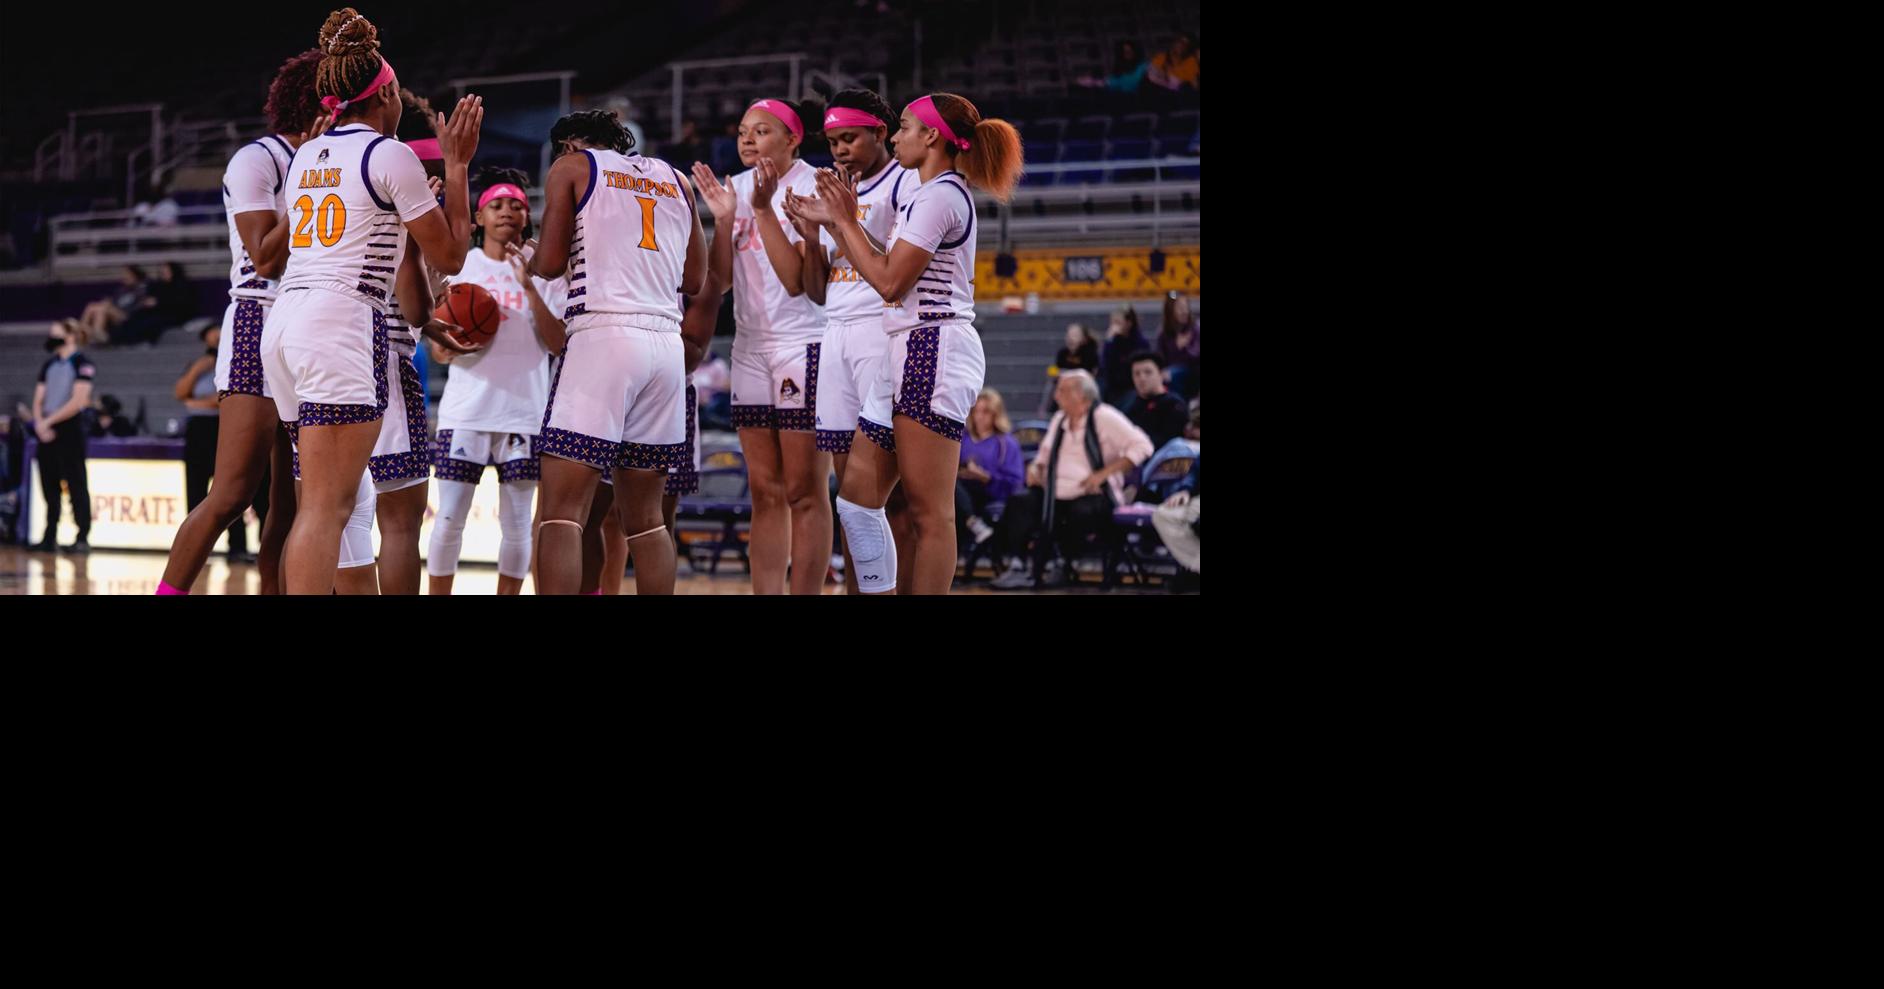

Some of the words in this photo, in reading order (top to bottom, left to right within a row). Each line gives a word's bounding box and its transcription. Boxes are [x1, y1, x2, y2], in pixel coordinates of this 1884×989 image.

[298, 167, 342, 189] ADAMS
[602, 169, 680, 199] THOMPSON
[292, 193, 347, 249] 20
[634, 195, 660, 252] 1
[91, 495, 178, 524] PIRATE
